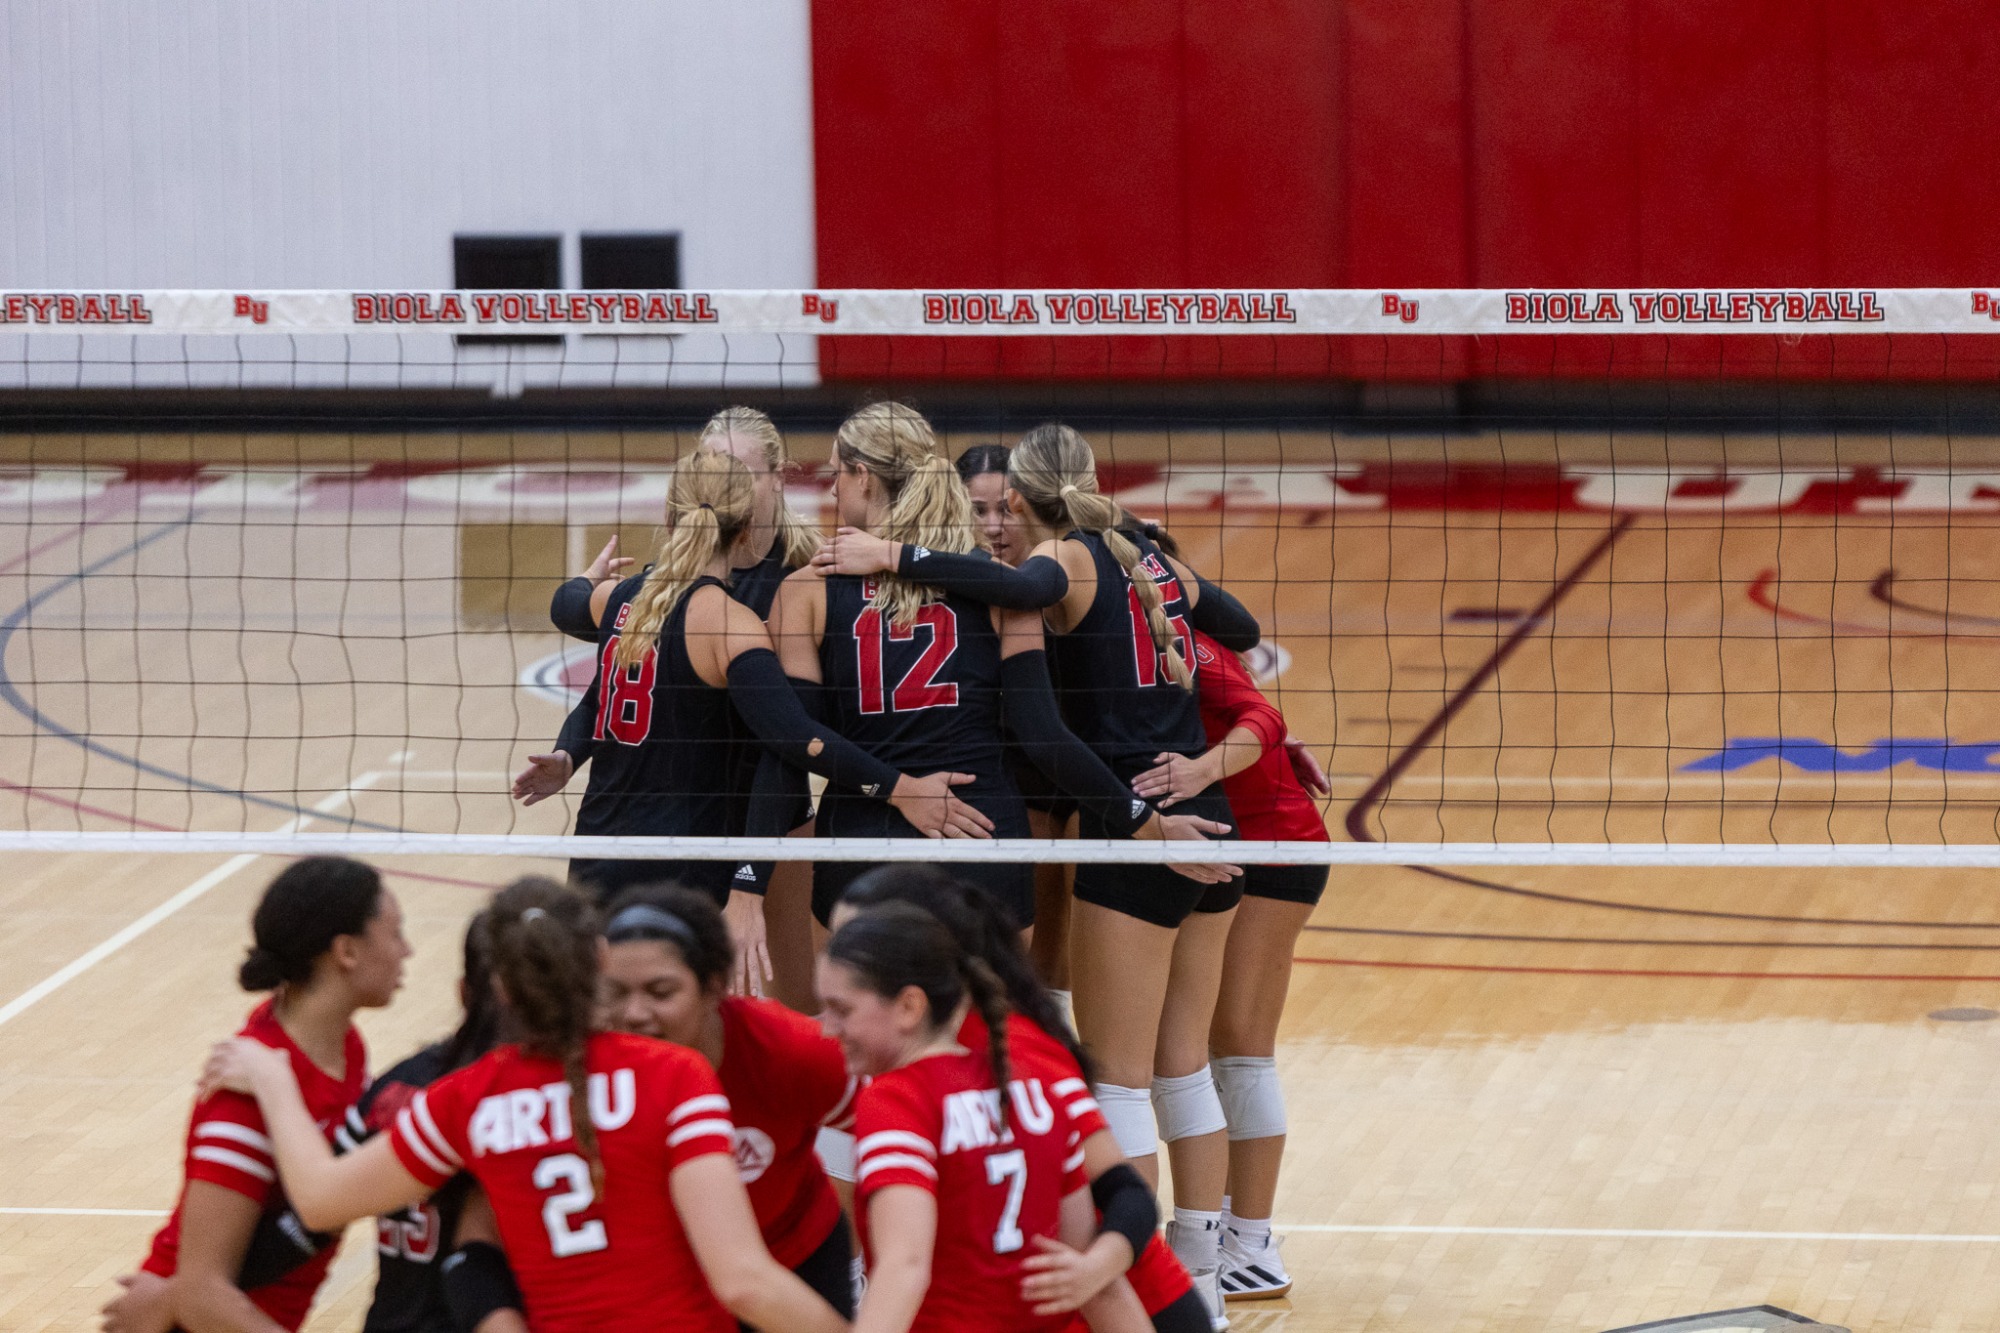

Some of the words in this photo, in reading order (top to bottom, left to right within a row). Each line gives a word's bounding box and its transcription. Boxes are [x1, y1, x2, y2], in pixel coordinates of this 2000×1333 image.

[0, 294, 152, 323] EYBALL
[234, 295, 269, 324] BU
[353, 293, 466, 323] BIOLA
[471, 293, 718, 323] VOLLEYBALL
[803, 294, 838, 323] BU
[923, 293, 1038, 323] BIOLA
[1045, 293, 1296, 323] VOLLEYBALL
[1381, 293, 1419, 323] BU
[1506, 292, 1623, 323] BIOLA
[1629, 291, 1884, 322] VOLLEYBALL
[1128, 577, 1197, 687] 15
[853, 602, 958, 714] 12
[592, 635, 658, 746] 18
[467, 1081, 573, 1158] ART
[586, 1067, 637, 1131] U
[1008, 1077, 1054, 1135] U
[532, 1153, 609, 1258] 2
[985, 1149, 1028, 1255] 7
